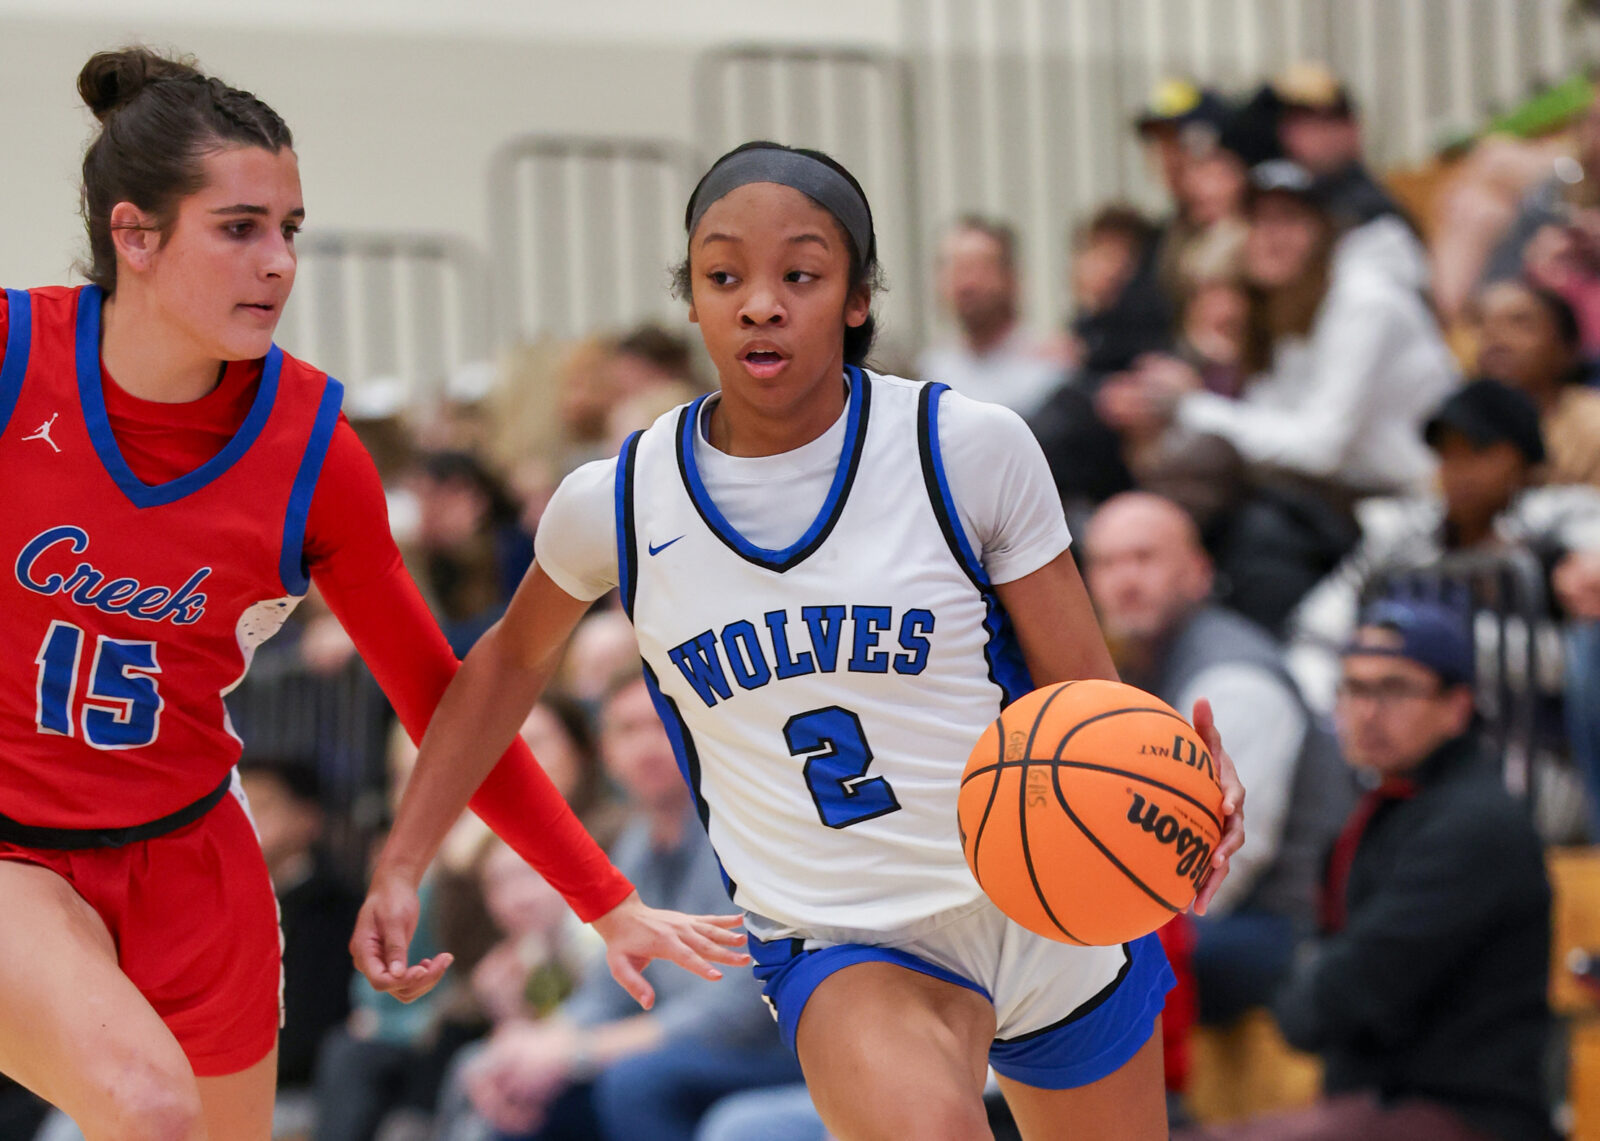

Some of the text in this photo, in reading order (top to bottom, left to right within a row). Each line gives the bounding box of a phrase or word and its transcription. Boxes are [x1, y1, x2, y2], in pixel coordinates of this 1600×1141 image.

[15, 525, 212, 625] Creek
[34, 619, 164, 750] 15
[667, 605, 935, 708] WOLVES
[782, 705, 902, 829] 2
[1139, 744, 1169, 757] NXT
